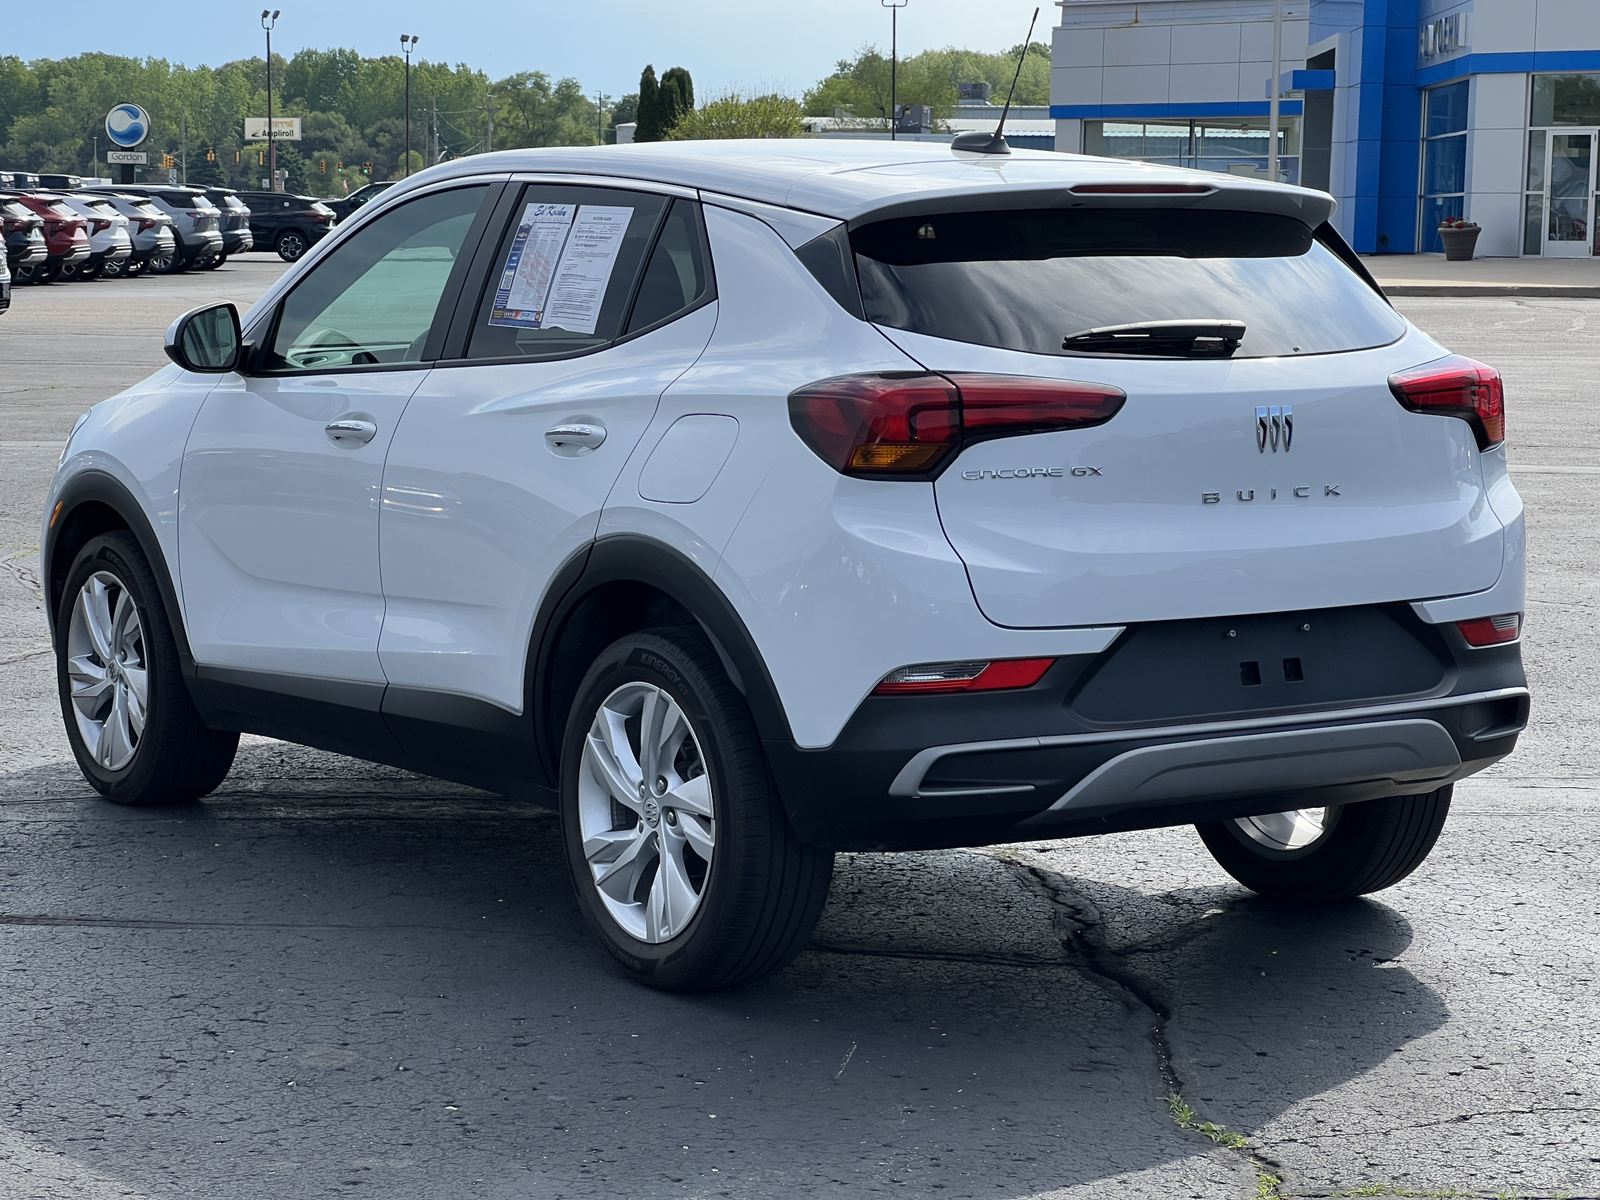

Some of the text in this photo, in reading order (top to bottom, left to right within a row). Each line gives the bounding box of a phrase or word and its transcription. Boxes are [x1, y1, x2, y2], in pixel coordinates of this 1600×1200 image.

[112, 153, 142, 161] Gordon
[534, 205, 548, 216] Ed
[962, 465, 1103, 480] ENCORE GX
[1202, 484, 1341, 504] BUICK
[640, 653, 689, 696] KINERGY GT
